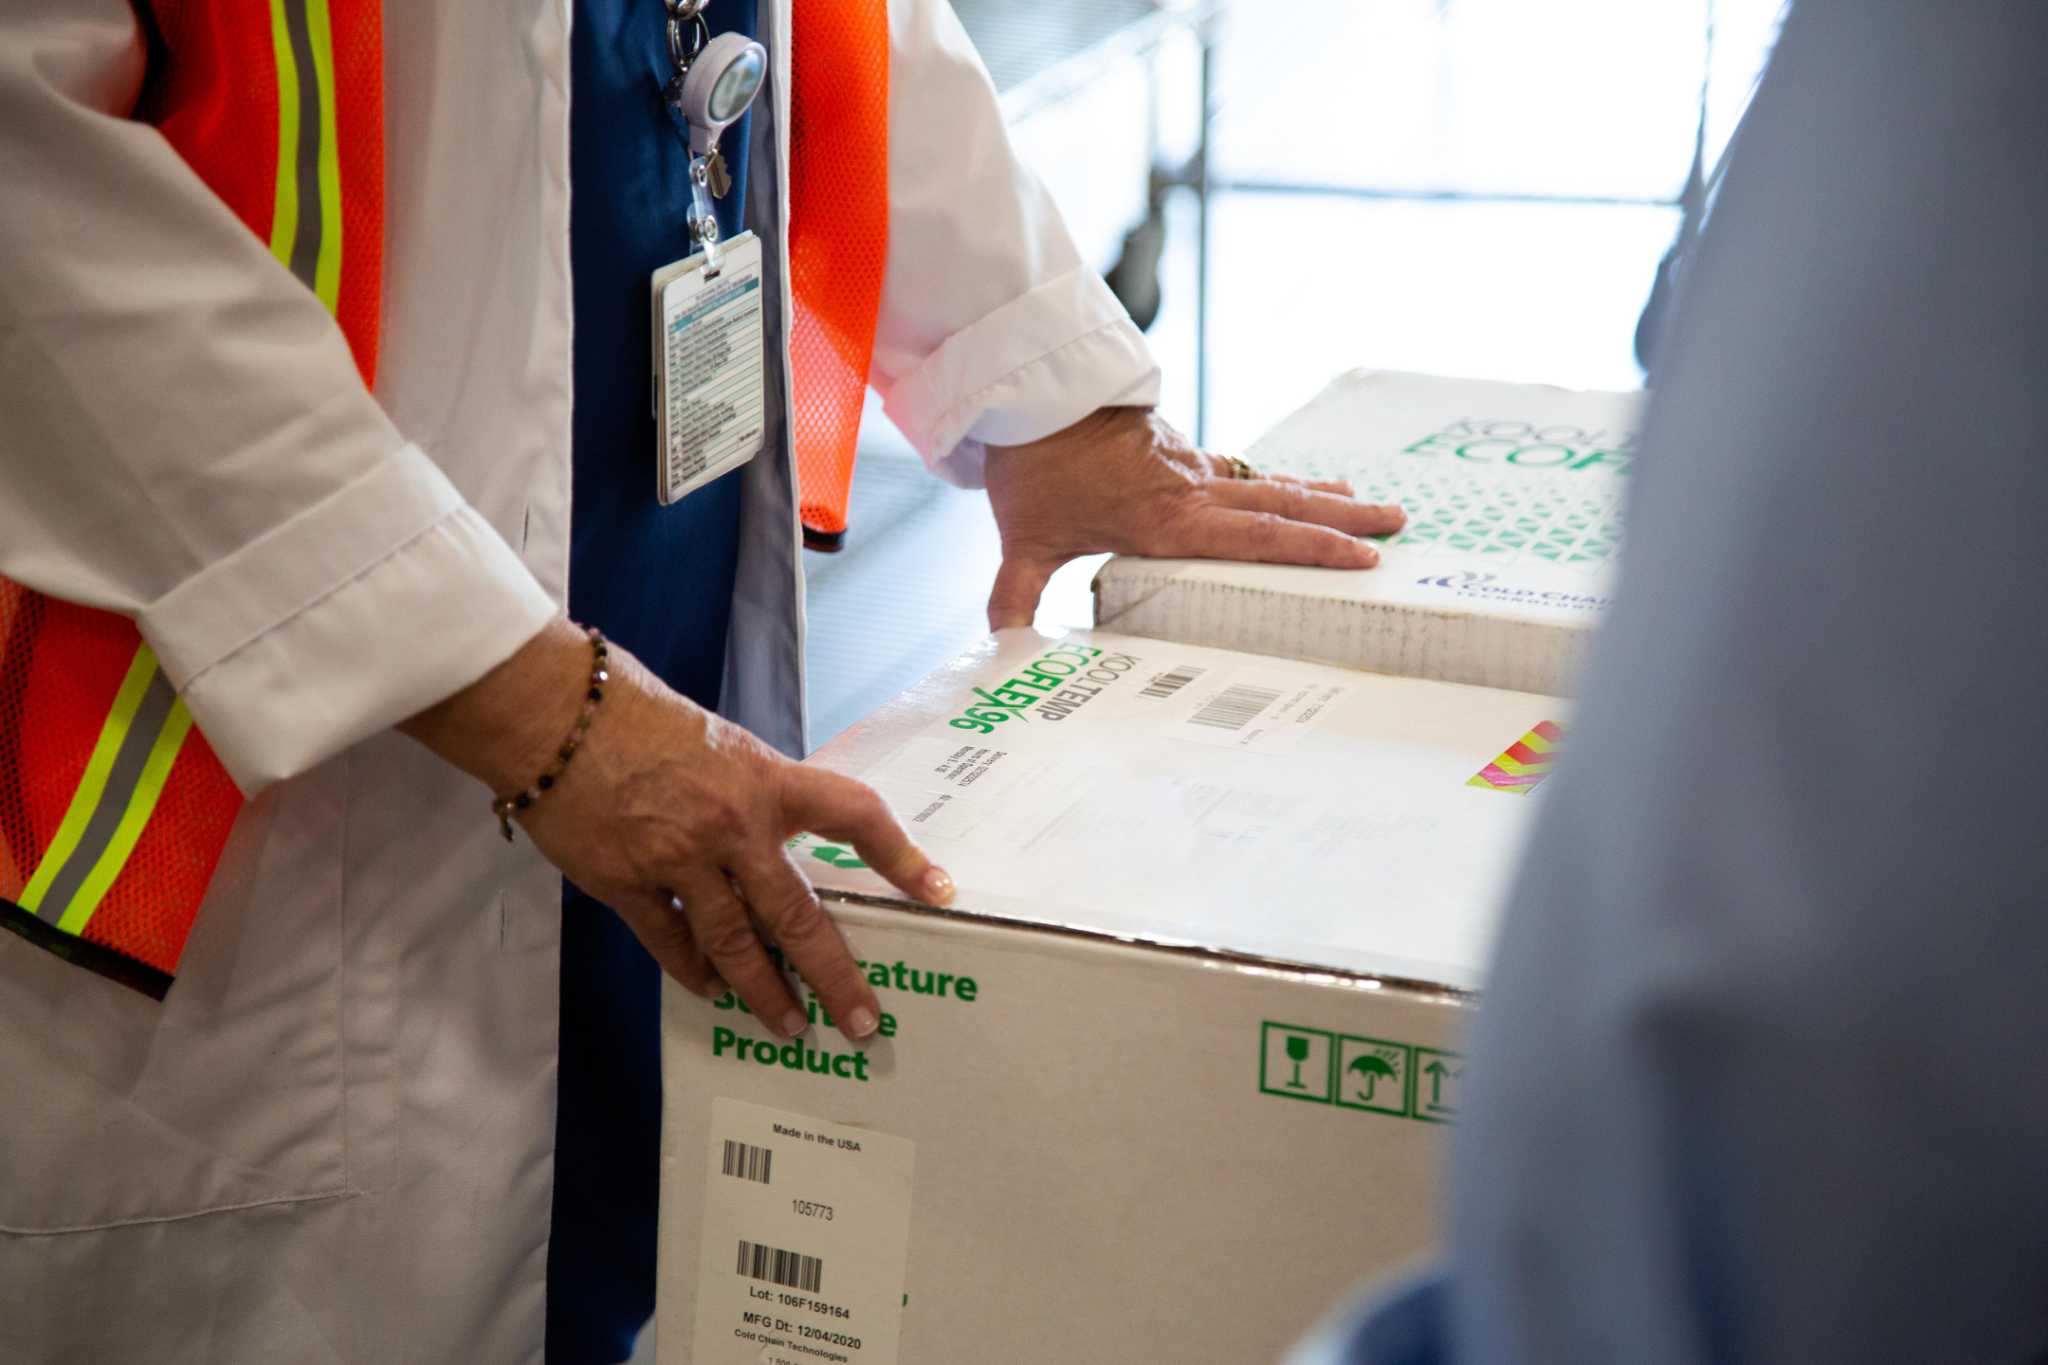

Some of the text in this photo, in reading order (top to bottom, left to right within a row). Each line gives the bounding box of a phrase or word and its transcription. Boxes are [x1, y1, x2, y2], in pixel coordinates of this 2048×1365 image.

[1035, 652, 1143, 722] KOOLTEMP
[712, 1026, 869, 1082] Product
[773, 1123, 862, 1152] Made in the USA
[792, 1199, 834, 1221] 105773
[749, 1286, 850, 1320] Lot: 106F159164
[734, 1328, 757, 1342] Cold
[787, 1341, 849, 1364] Technologies
[743, 1312, 862, 1350] MFG Dt: 12/04/2020
